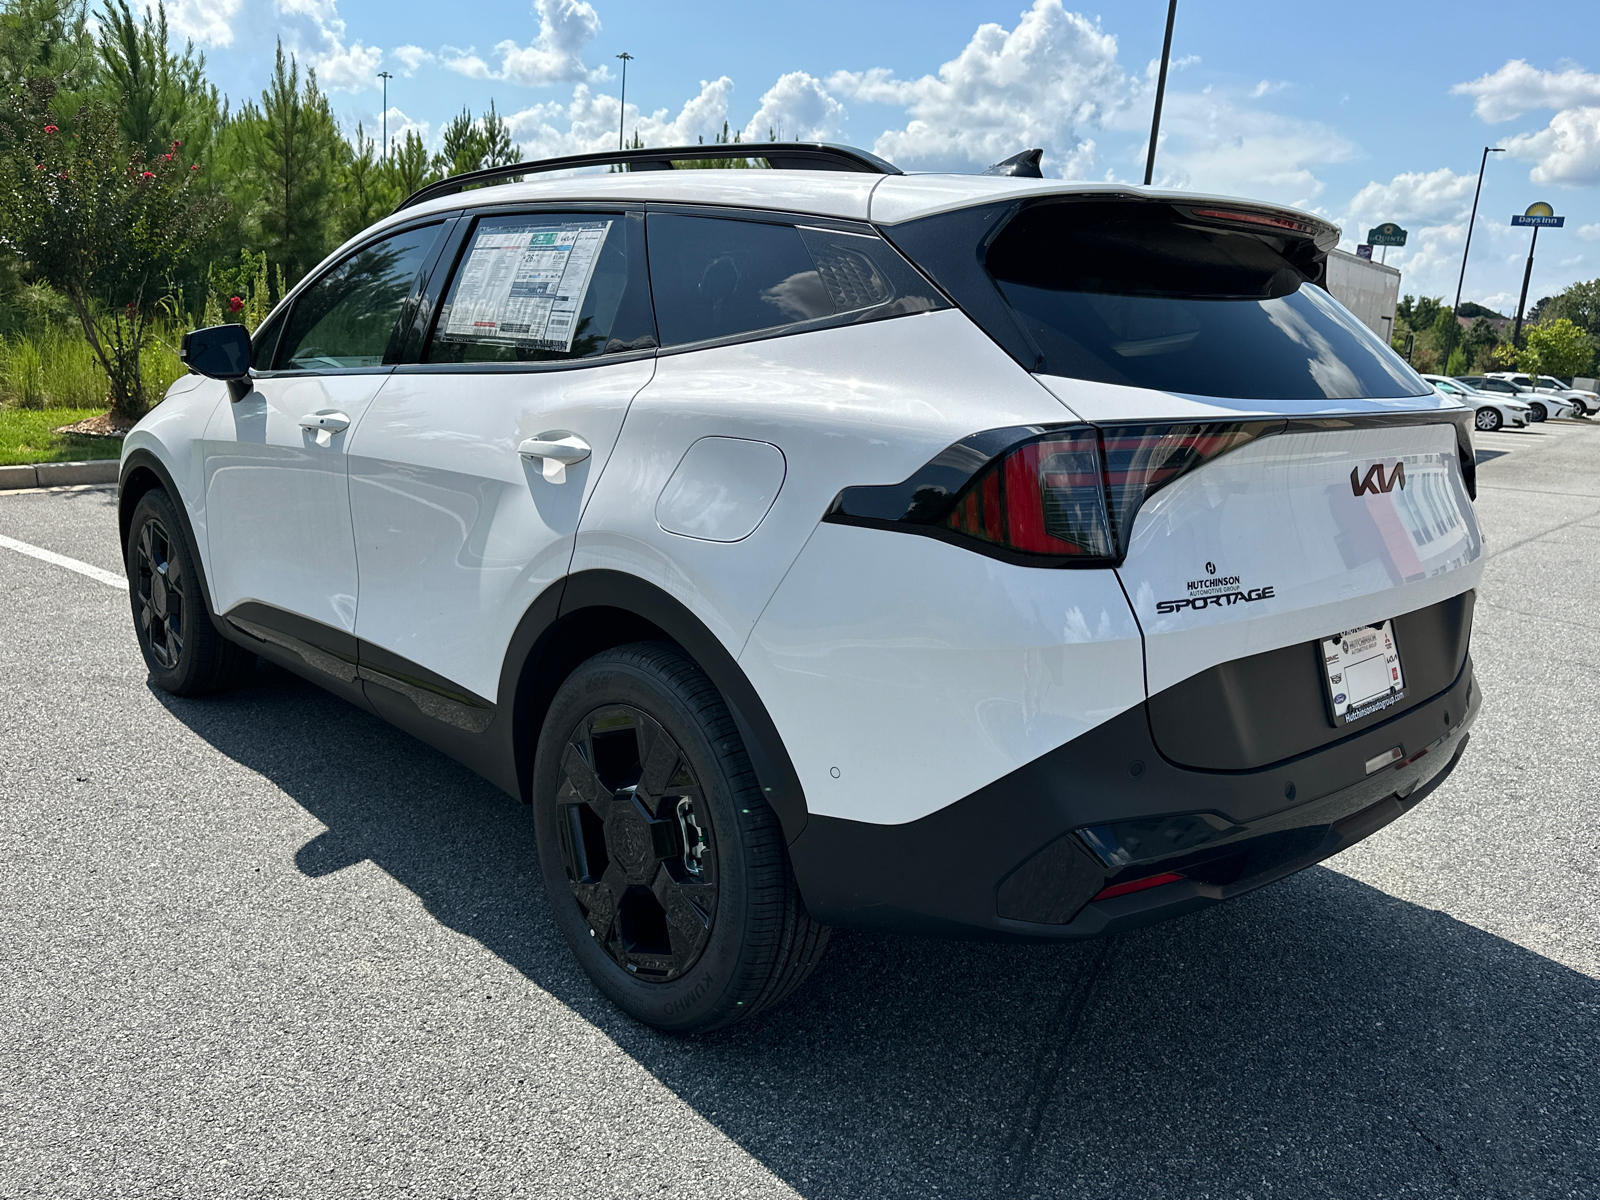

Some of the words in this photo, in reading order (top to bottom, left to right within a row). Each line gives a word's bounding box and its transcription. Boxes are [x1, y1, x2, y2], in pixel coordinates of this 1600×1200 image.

[1518, 216, 1541, 225] Days
[1541, 217, 1558, 225] Inn
[1374, 234, 1405, 244] QUINTA
[1350, 461, 1407, 497] KIA
[1187, 575, 1241, 591] HUTCHINSON
[1189, 587, 1223, 597] AUTOMOTIVE
[1223, 584, 1241, 594] GROUP
[1156, 585, 1276, 614] SPORTAGE
[1386, 653, 1398, 664] KIA
[1344, 691, 1405, 723] Hutchinsonautogroup.com
[663, 970, 714, 1016] KUMHO
